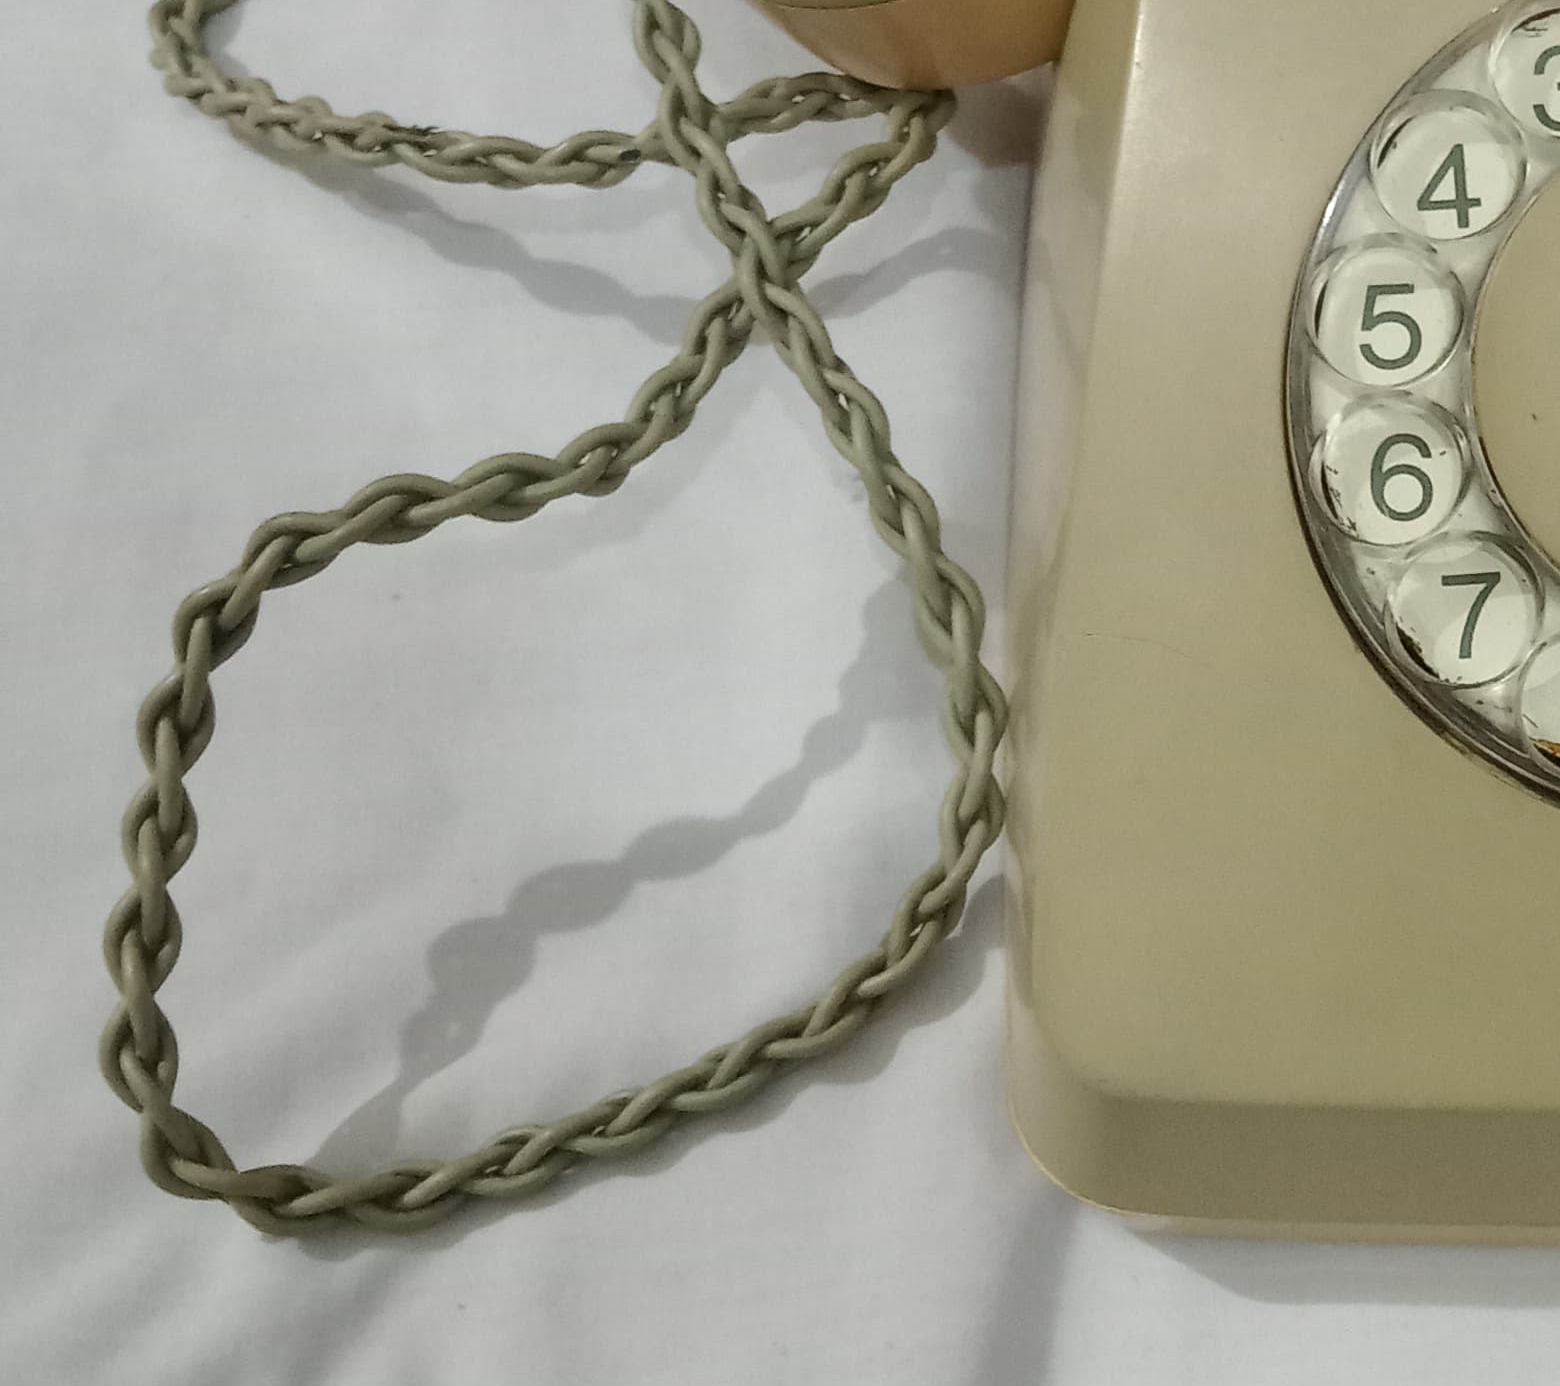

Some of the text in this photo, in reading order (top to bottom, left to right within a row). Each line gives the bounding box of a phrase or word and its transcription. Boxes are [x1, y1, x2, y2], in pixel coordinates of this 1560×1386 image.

[1416, 144, 1481, 229] 4
[1359, 283, 1422, 369] 5
[1370, 433, 1434, 521] 6
[1441, 572, 1501, 659] 7
